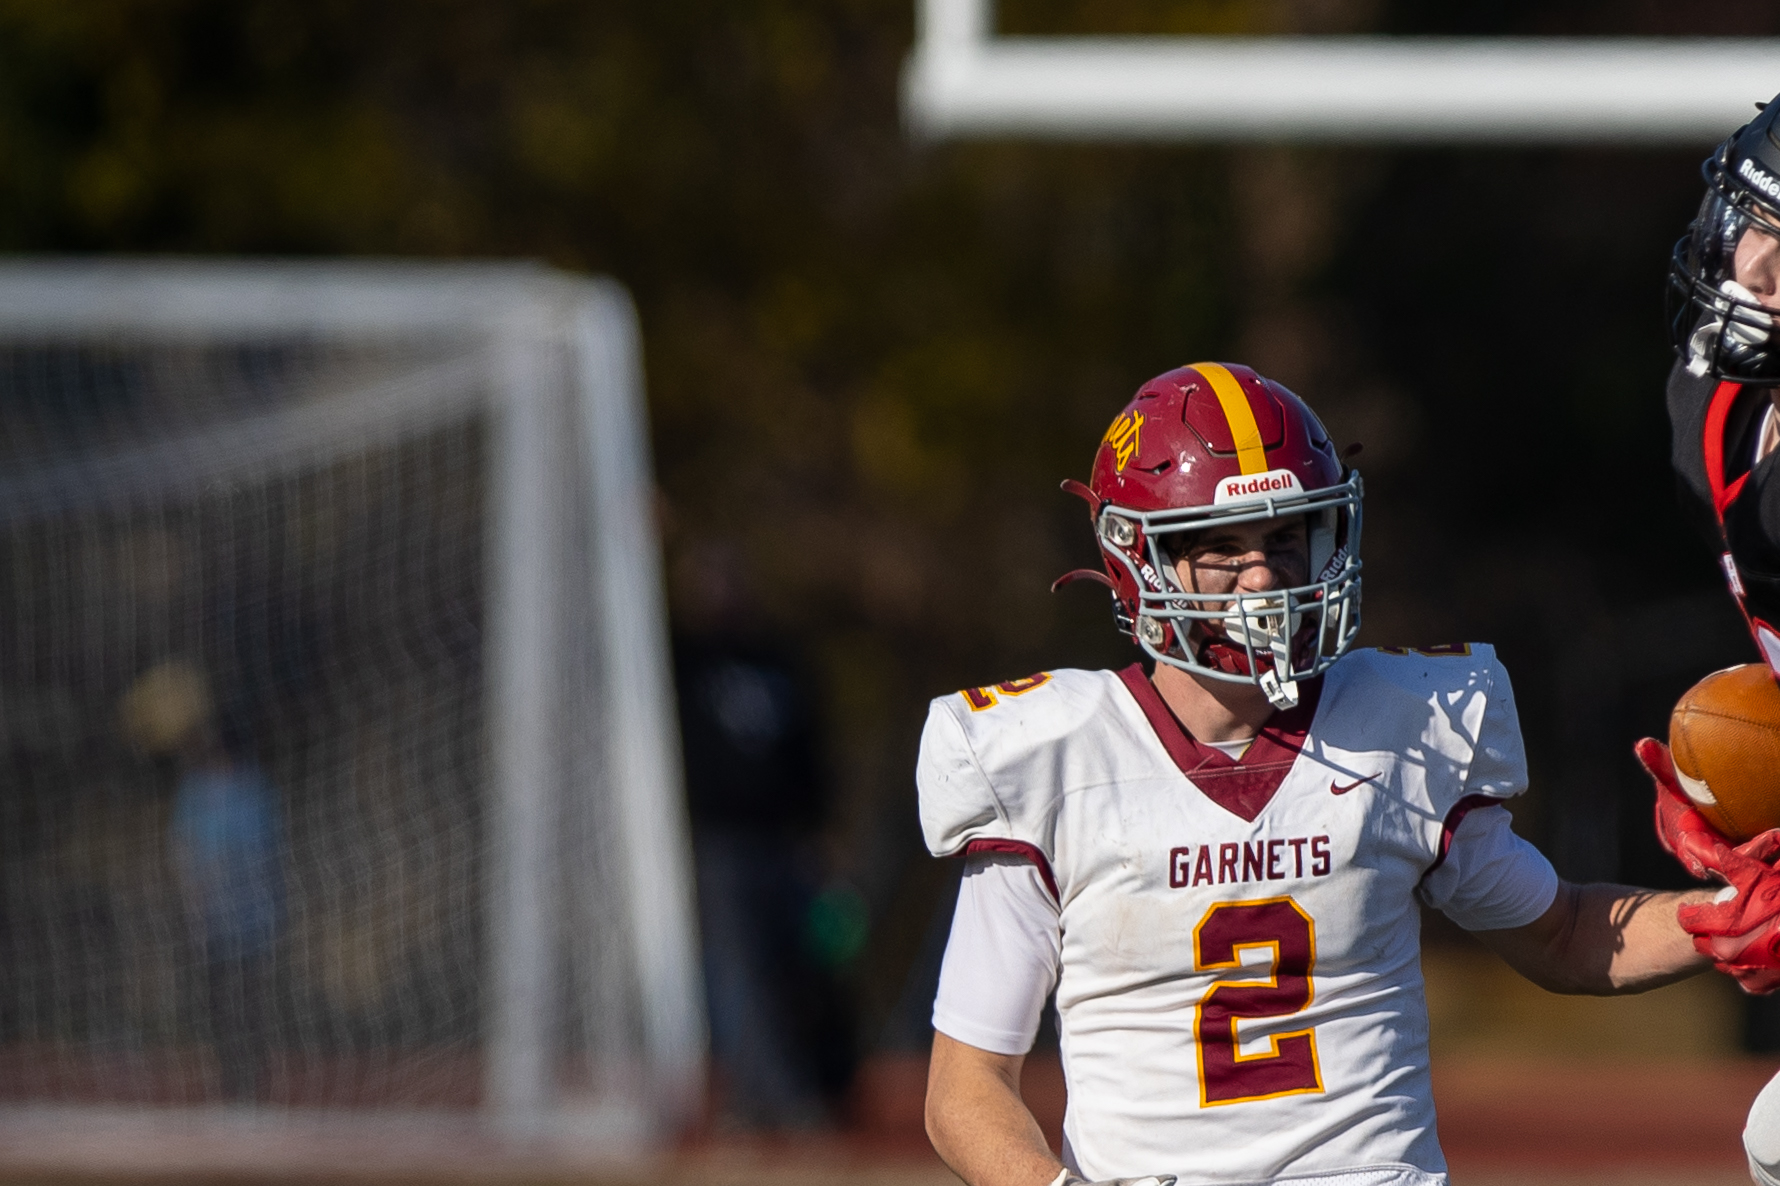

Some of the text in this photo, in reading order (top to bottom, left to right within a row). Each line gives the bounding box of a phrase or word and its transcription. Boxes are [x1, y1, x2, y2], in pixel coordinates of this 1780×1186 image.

[1226, 474, 1293, 497] Riddell
[1169, 835, 1331, 889] GARNETS
[1193, 895, 1325, 1109] 2
